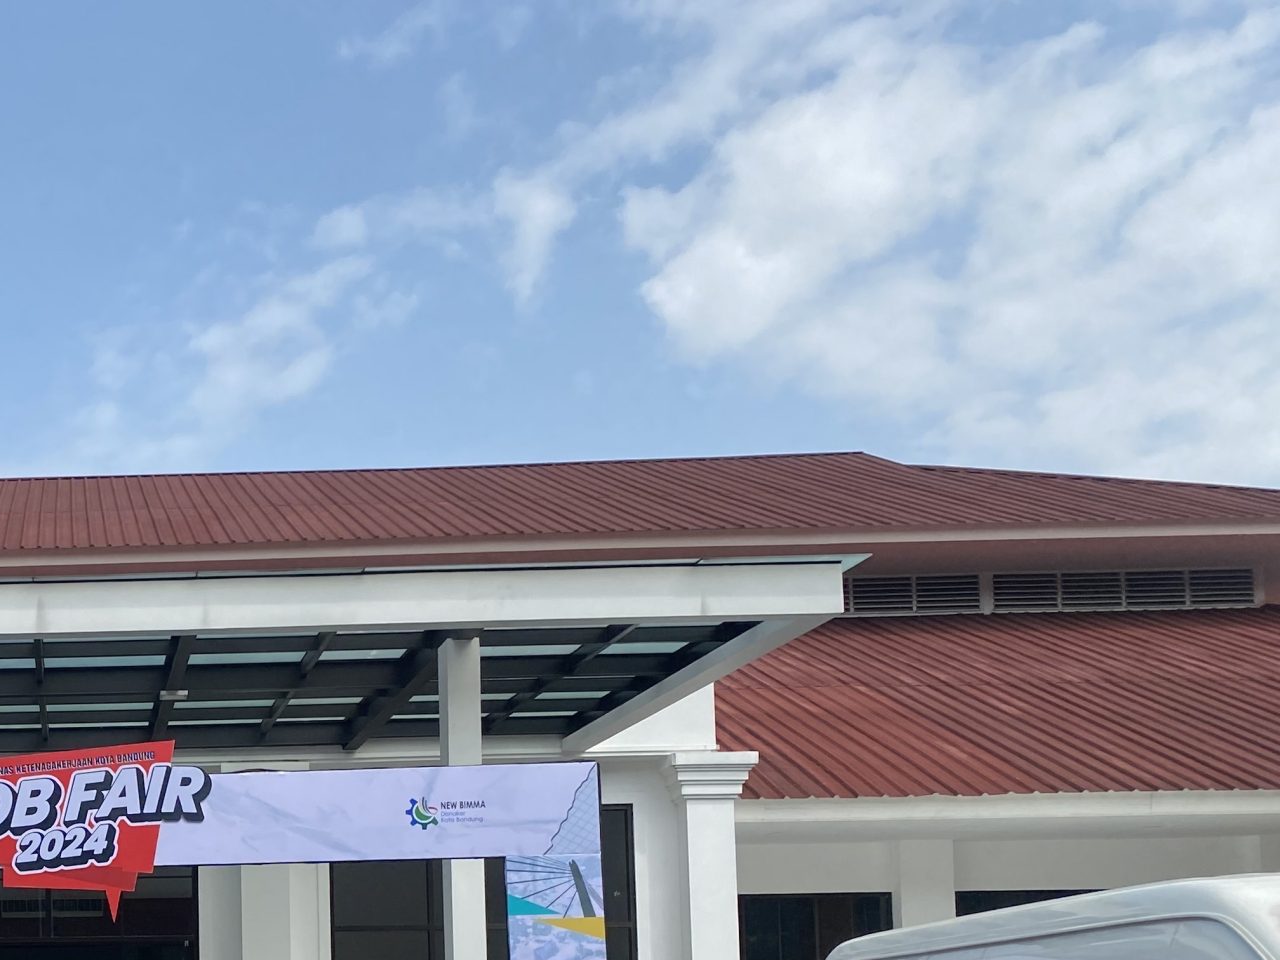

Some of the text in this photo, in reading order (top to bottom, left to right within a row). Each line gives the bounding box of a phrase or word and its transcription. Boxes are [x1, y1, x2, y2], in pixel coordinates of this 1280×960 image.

[95, 755, 115, 766] KOTA
[116, 750, 156, 763] BANDUNG
[63, 765, 212, 823] FAIR
[440, 800, 486, 810] NEW BIMMA
[456, 816, 484, 824] Bandung
[14, 822, 116, 871] 2024
